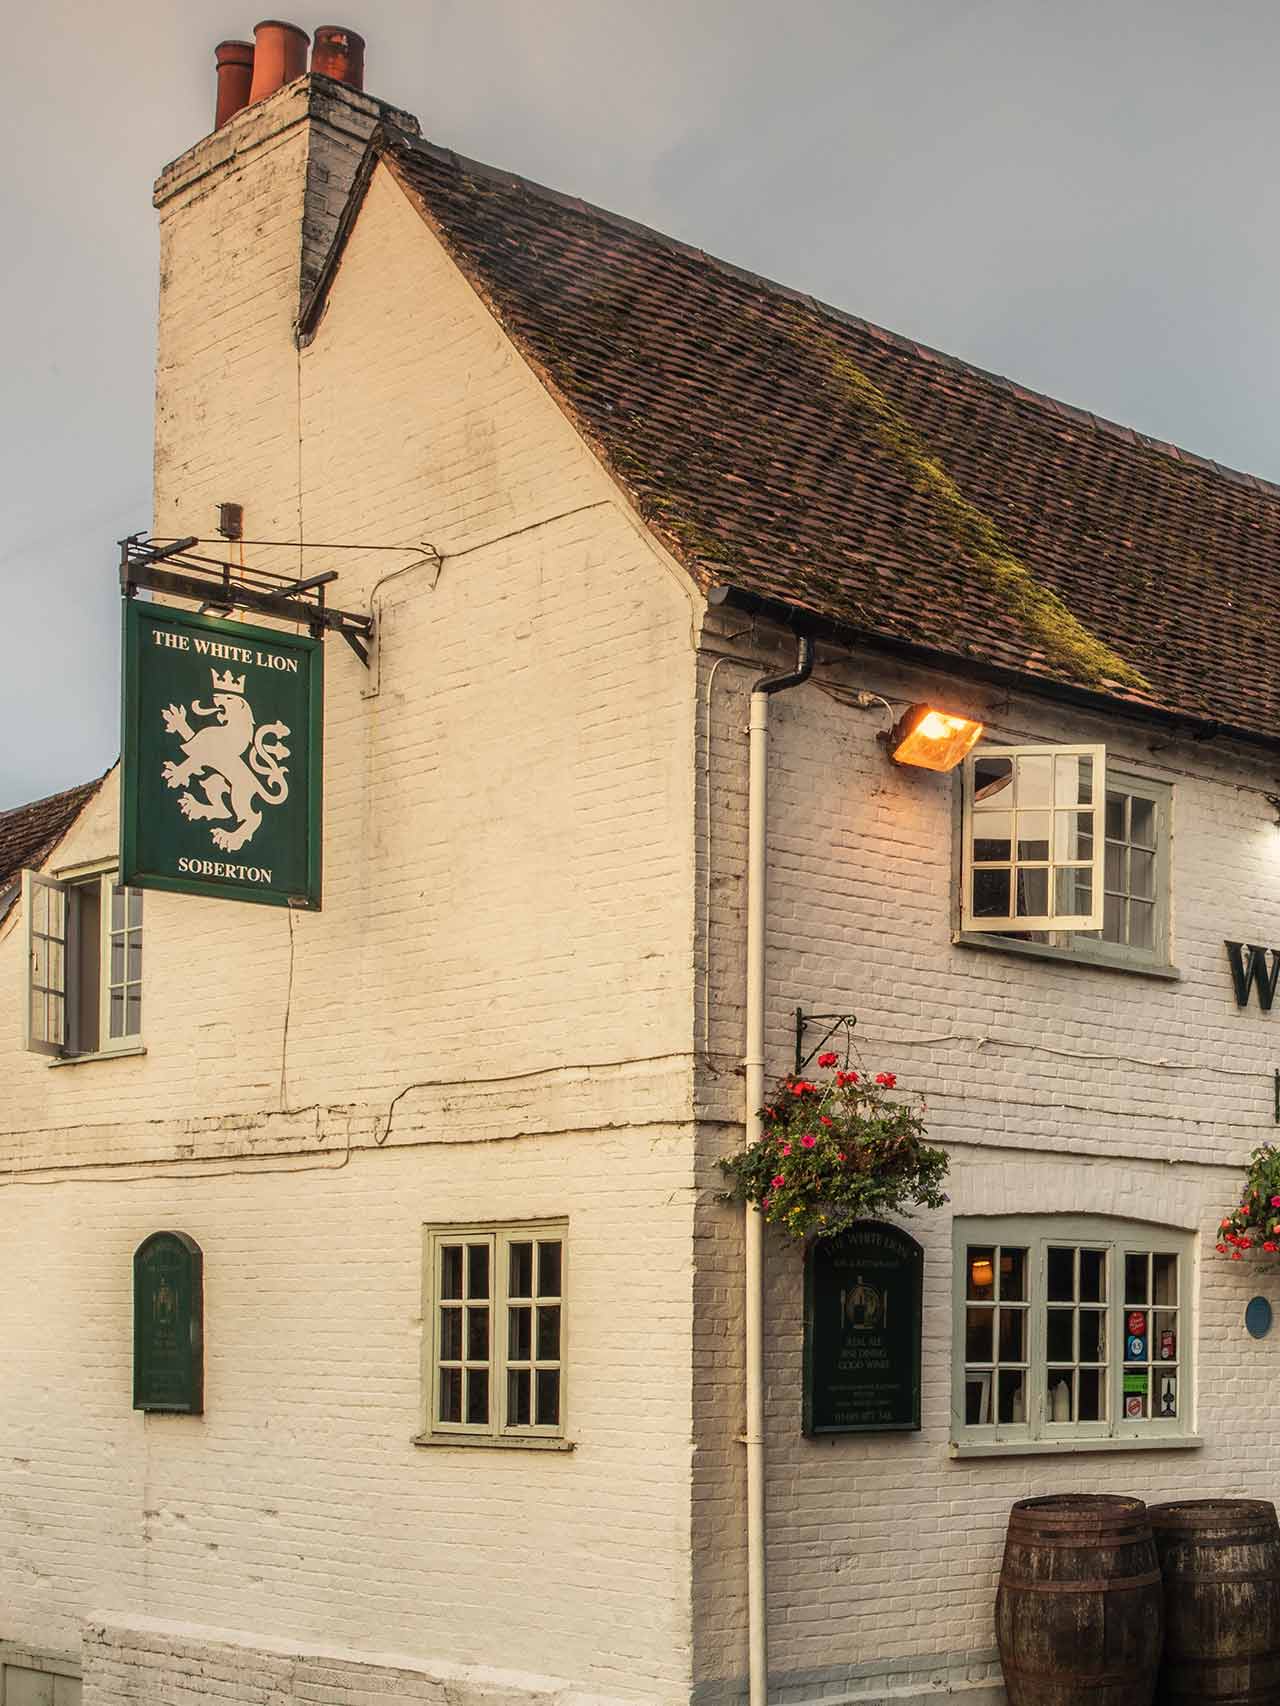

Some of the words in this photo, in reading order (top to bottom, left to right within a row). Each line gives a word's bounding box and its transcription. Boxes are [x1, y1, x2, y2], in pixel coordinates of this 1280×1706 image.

[153, 630, 190, 651] THE
[193, 638, 253, 664] WHITE
[256, 652, 298, 673] LION
[178, 857, 273, 883] SOBERTON
